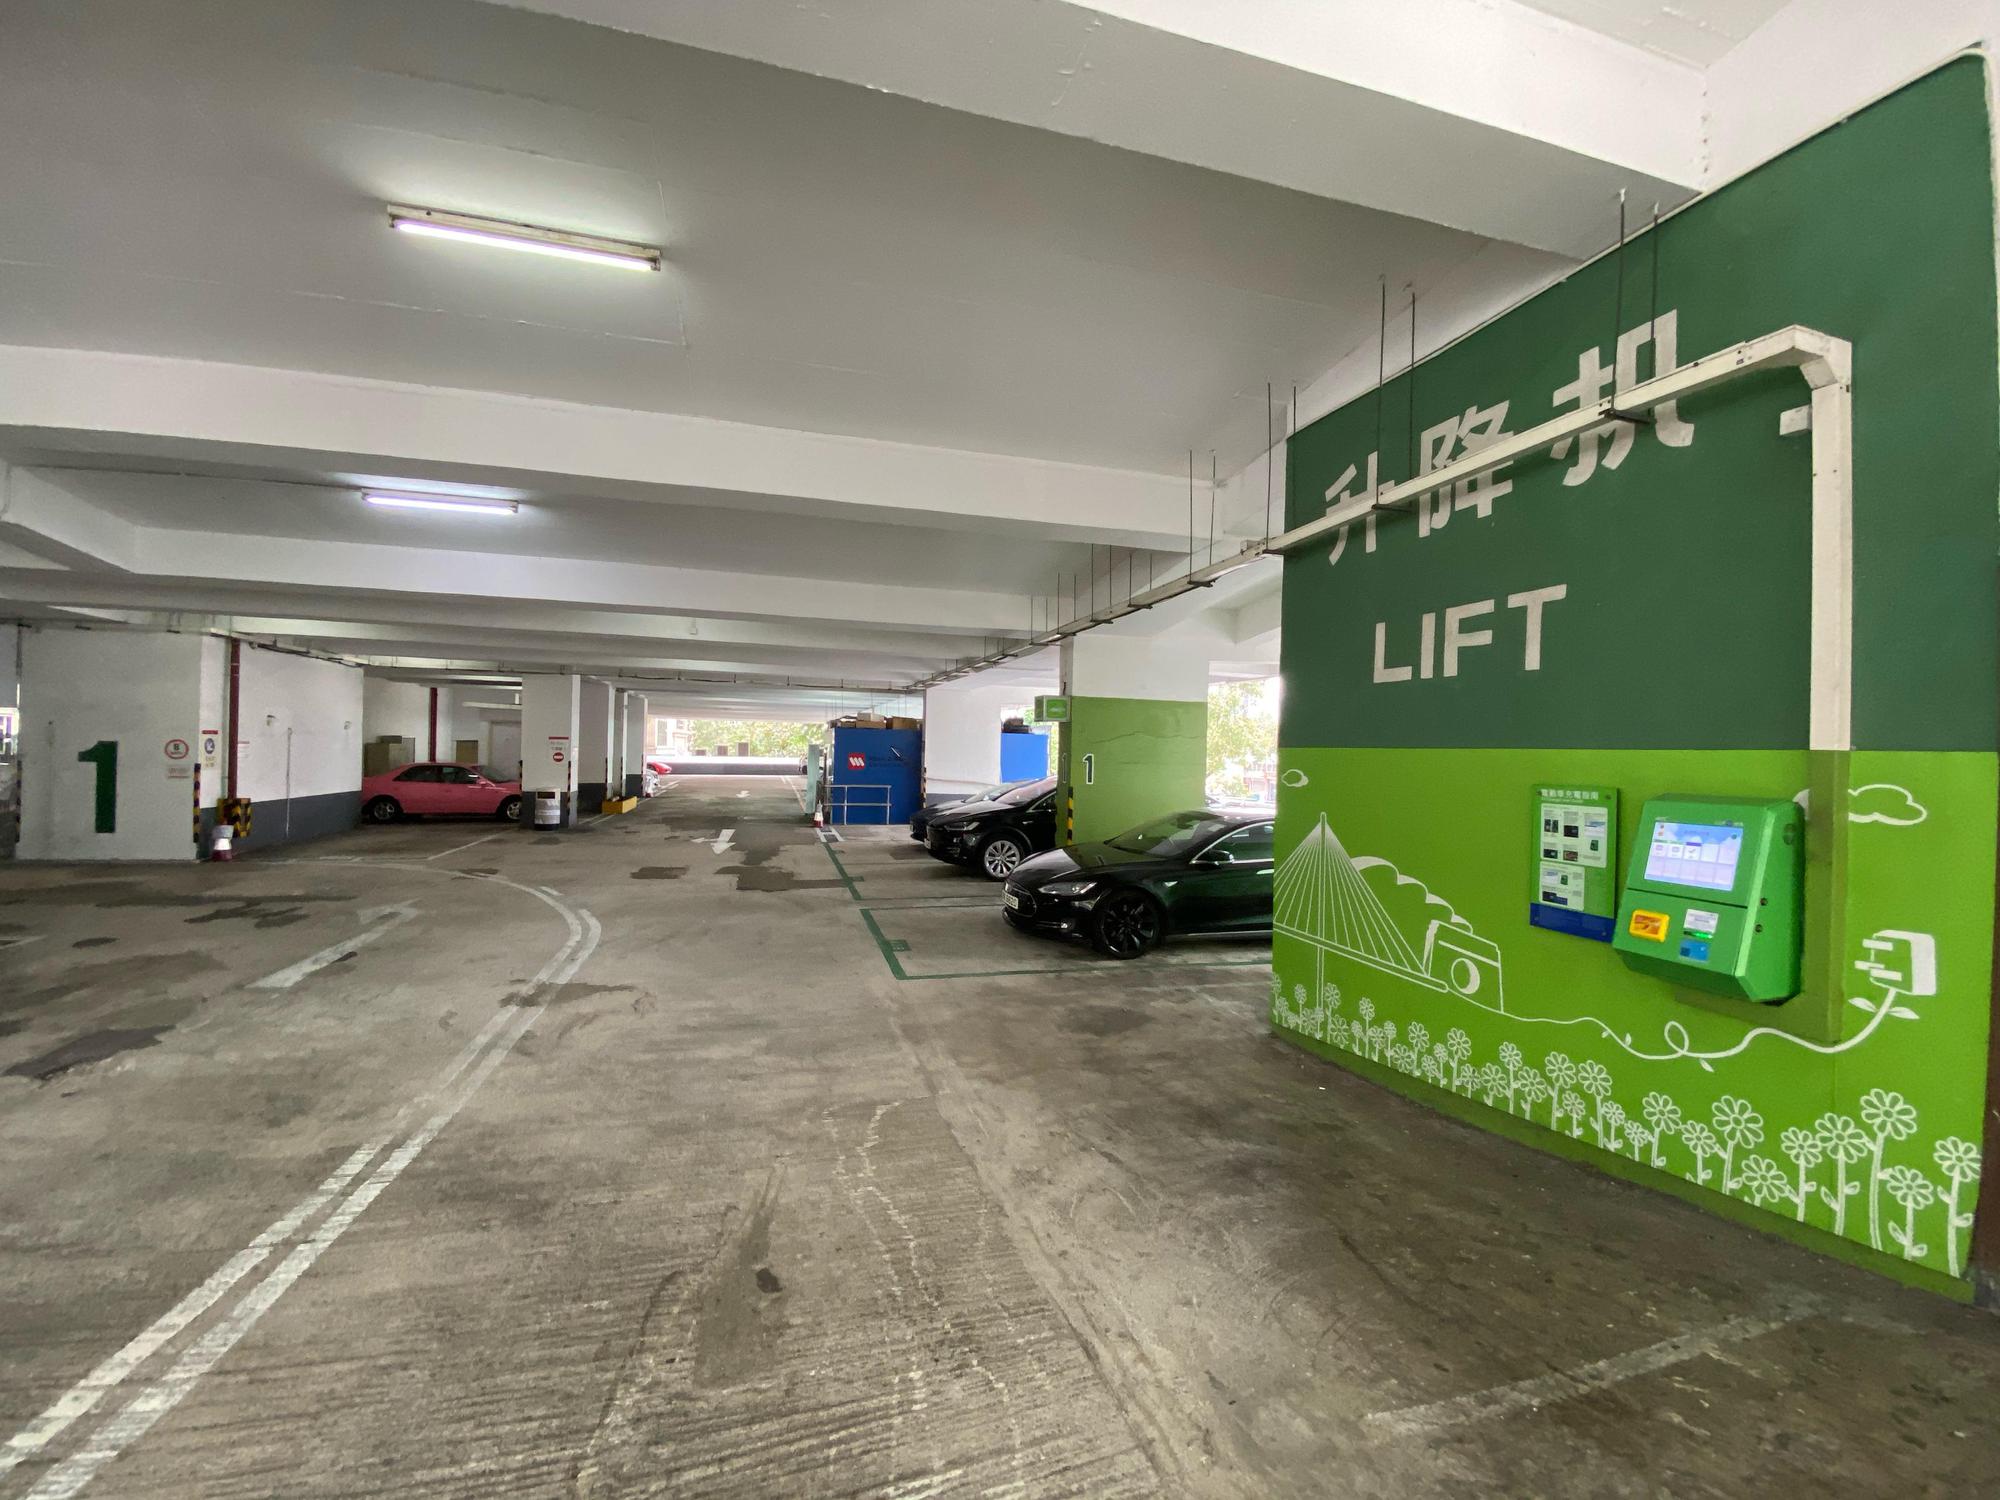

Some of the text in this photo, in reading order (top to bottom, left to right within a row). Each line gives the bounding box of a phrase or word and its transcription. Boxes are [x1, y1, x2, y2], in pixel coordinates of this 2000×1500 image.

[1326, 309, 1695, 566] 升降机
[1373, 584, 1567, 683] LIFT
[78, 740, 118, 834] 1
[1082, 753, 1095, 785] 1
